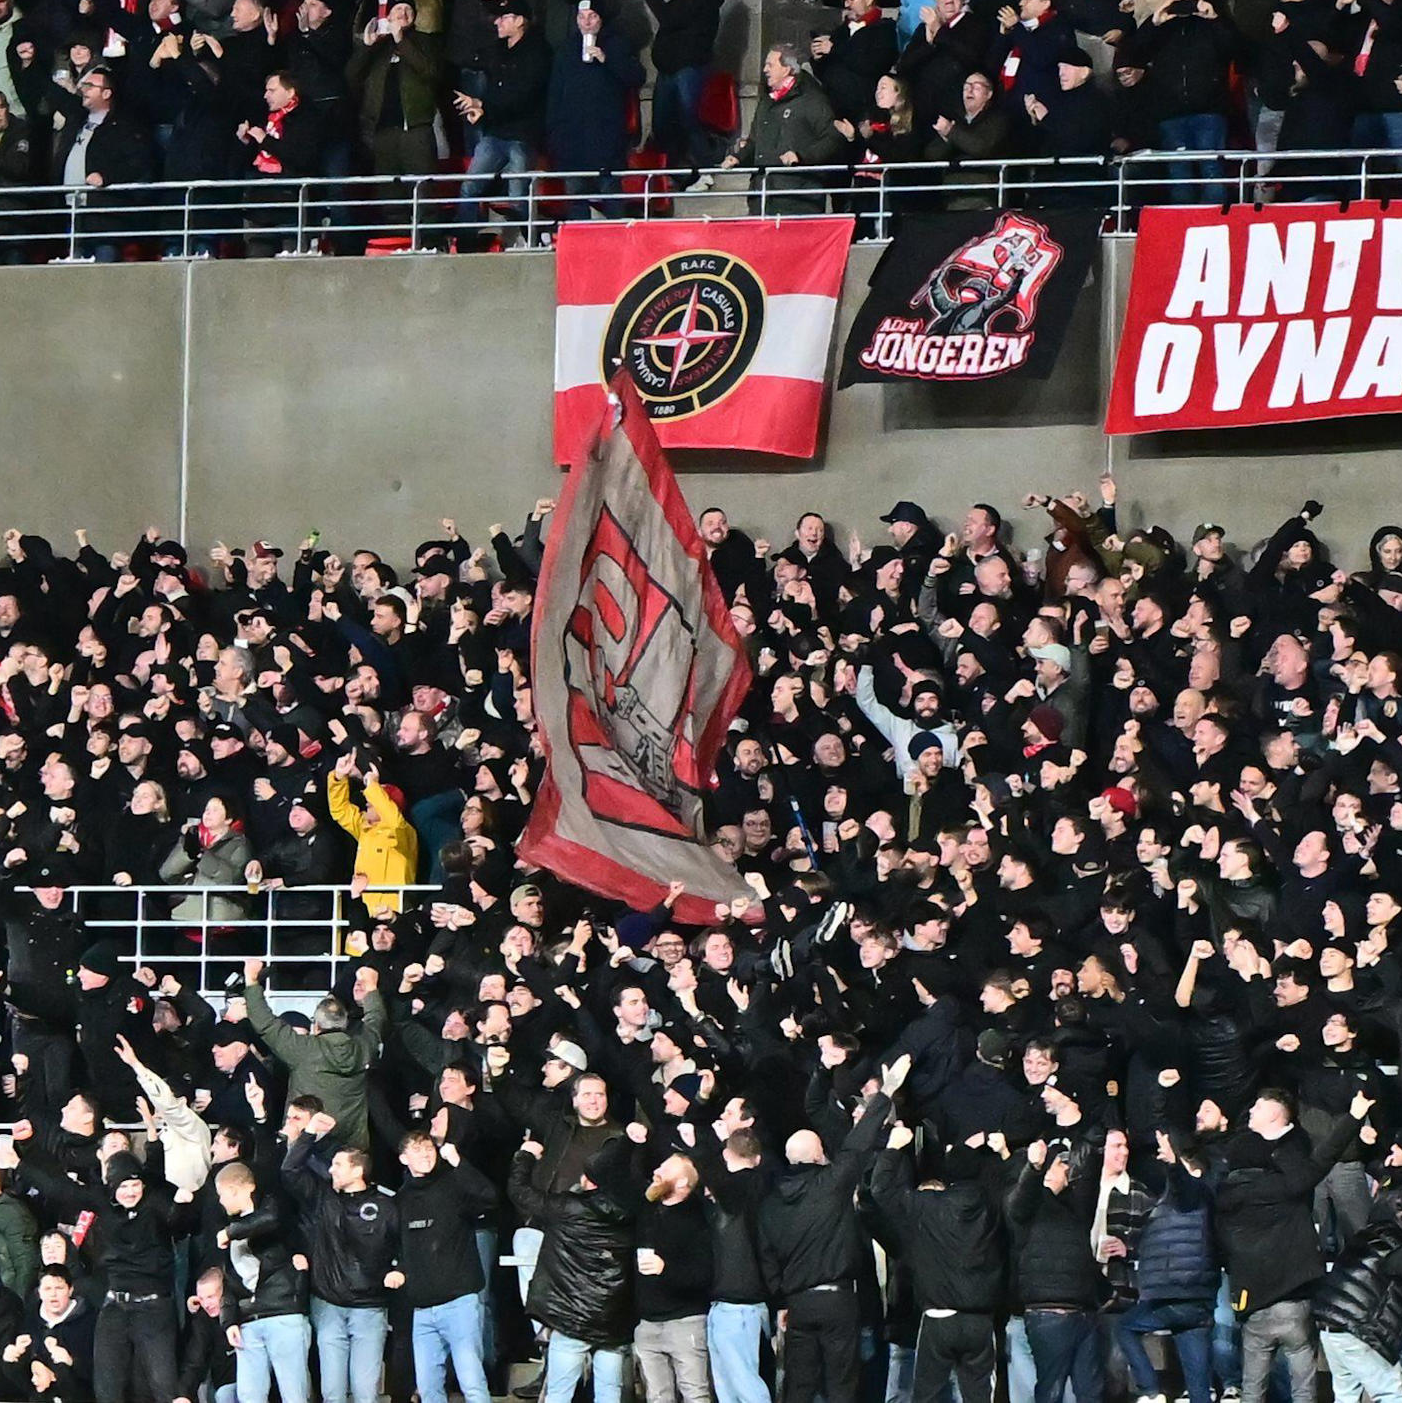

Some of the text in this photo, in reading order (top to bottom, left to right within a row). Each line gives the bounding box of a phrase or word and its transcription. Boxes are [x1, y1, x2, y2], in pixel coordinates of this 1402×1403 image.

[701, 286, 735, 330] CASUALS
[633, 346, 666, 388] CASUALS
[861, 333, 1031, 375] JONGEREN
